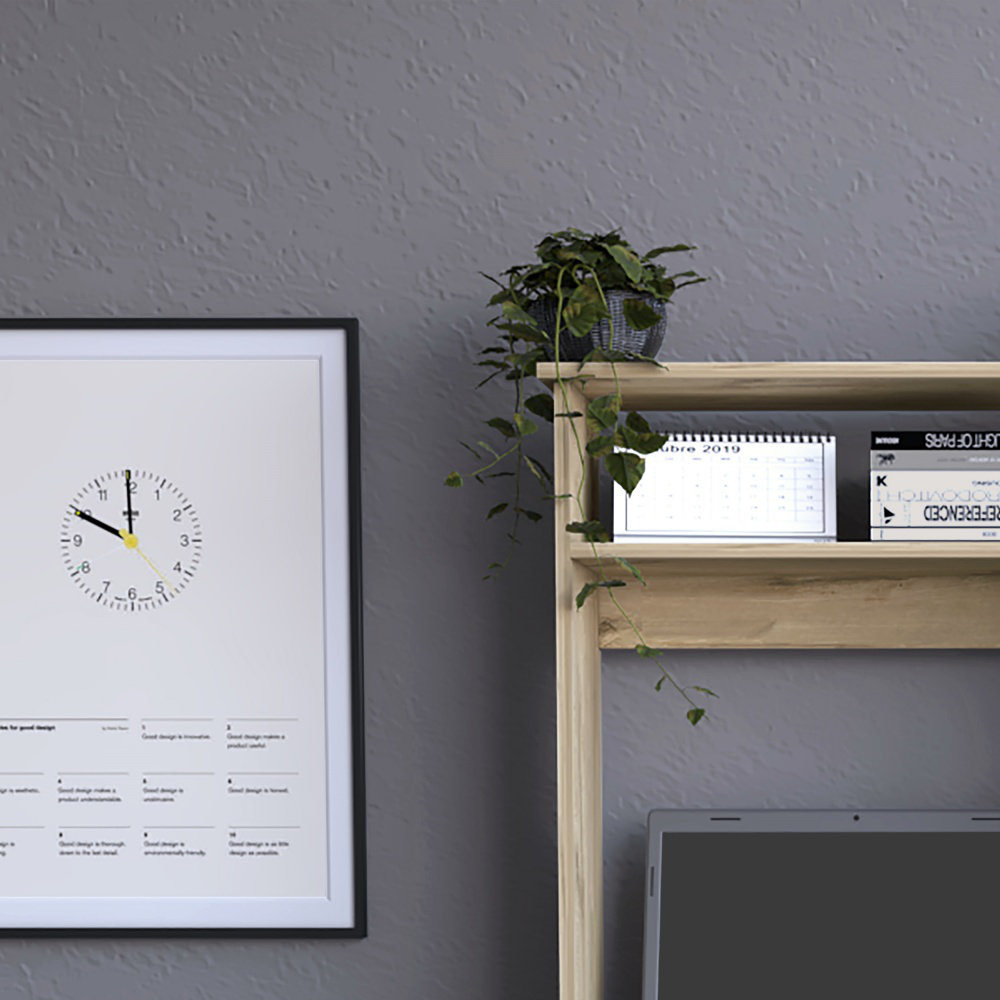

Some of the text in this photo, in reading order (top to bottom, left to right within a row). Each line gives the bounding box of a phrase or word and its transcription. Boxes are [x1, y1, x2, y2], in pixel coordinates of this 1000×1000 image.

[925, 433, 956, 448] PARIS
[957, 433, 972, 448] OF
[703, 445, 741, 453] 2019
